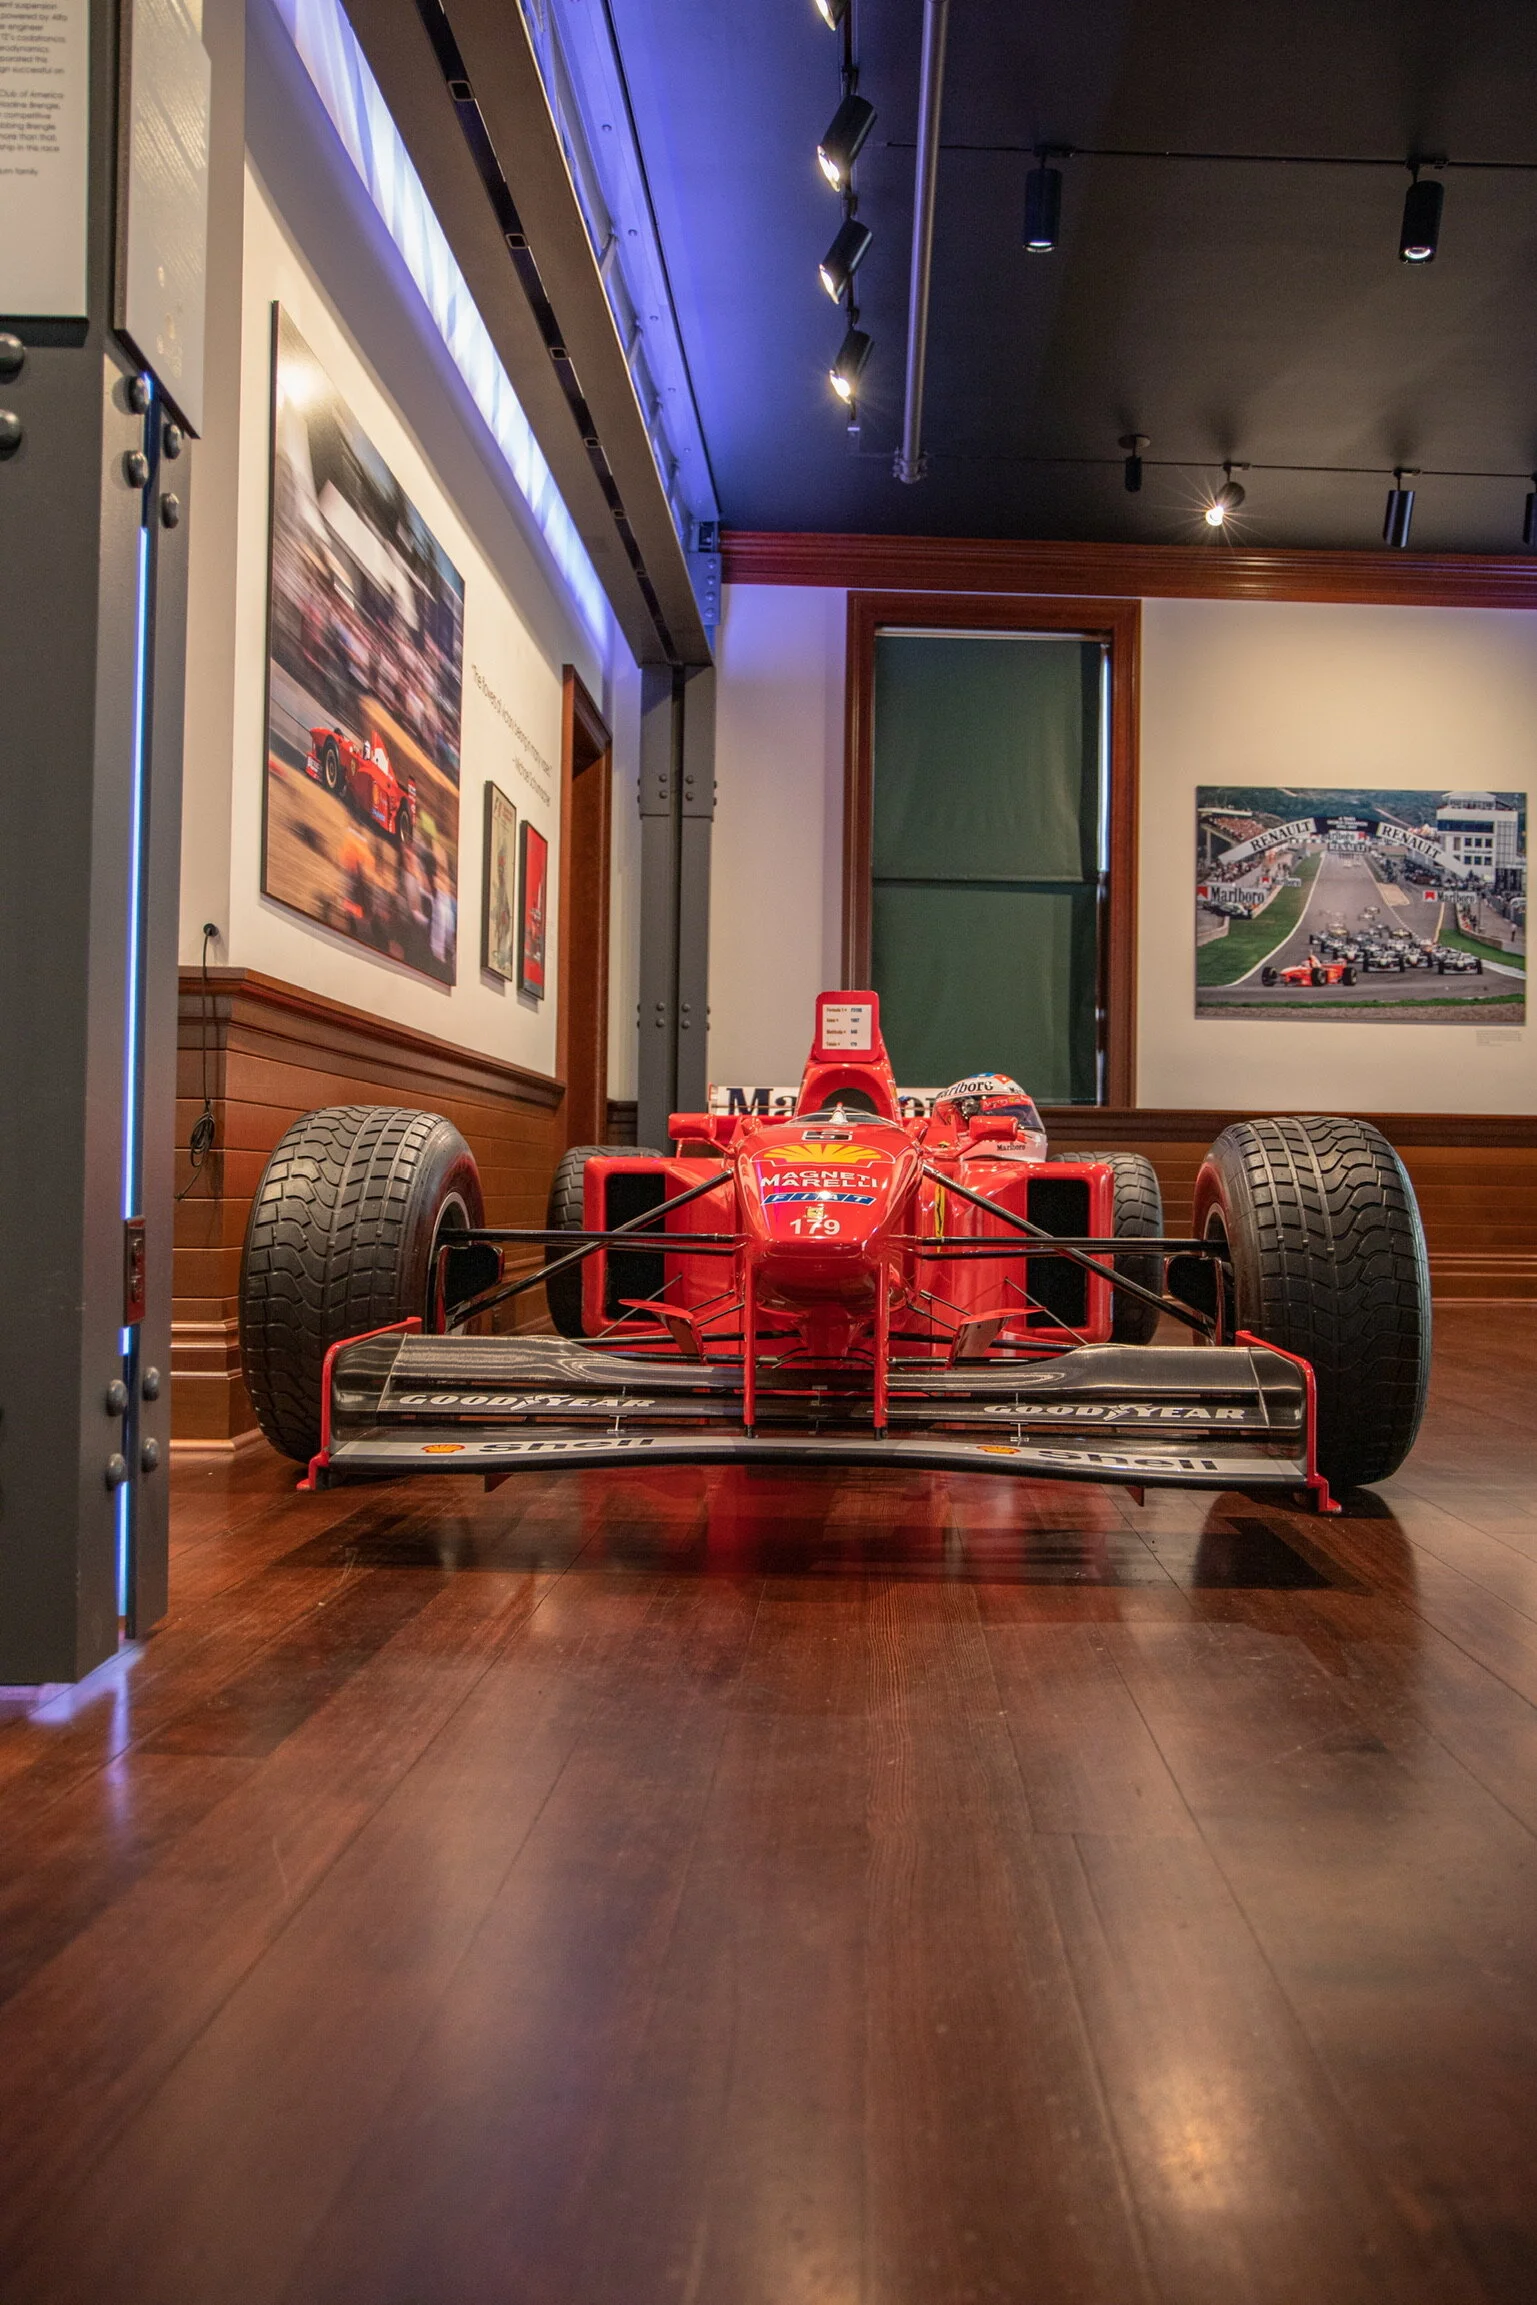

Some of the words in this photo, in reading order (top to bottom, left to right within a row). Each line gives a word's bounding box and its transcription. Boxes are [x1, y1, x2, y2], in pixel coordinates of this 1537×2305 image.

[1250, 821, 1310, 851] RENAULT
[1382, 825, 1442, 859] RENAULT
[1211, 886, 1265, 903] Marlboro
[996, 1143, 1026, 1151] Marlboro
[760, 1174, 878, 1188] MARELLI
[768, 1192, 870, 1203] FIAT
[790, 1219, 841, 1235] 179
[479, 1439, 655, 1452] Shell
[1038, 1450, 1219, 1471] Shell
